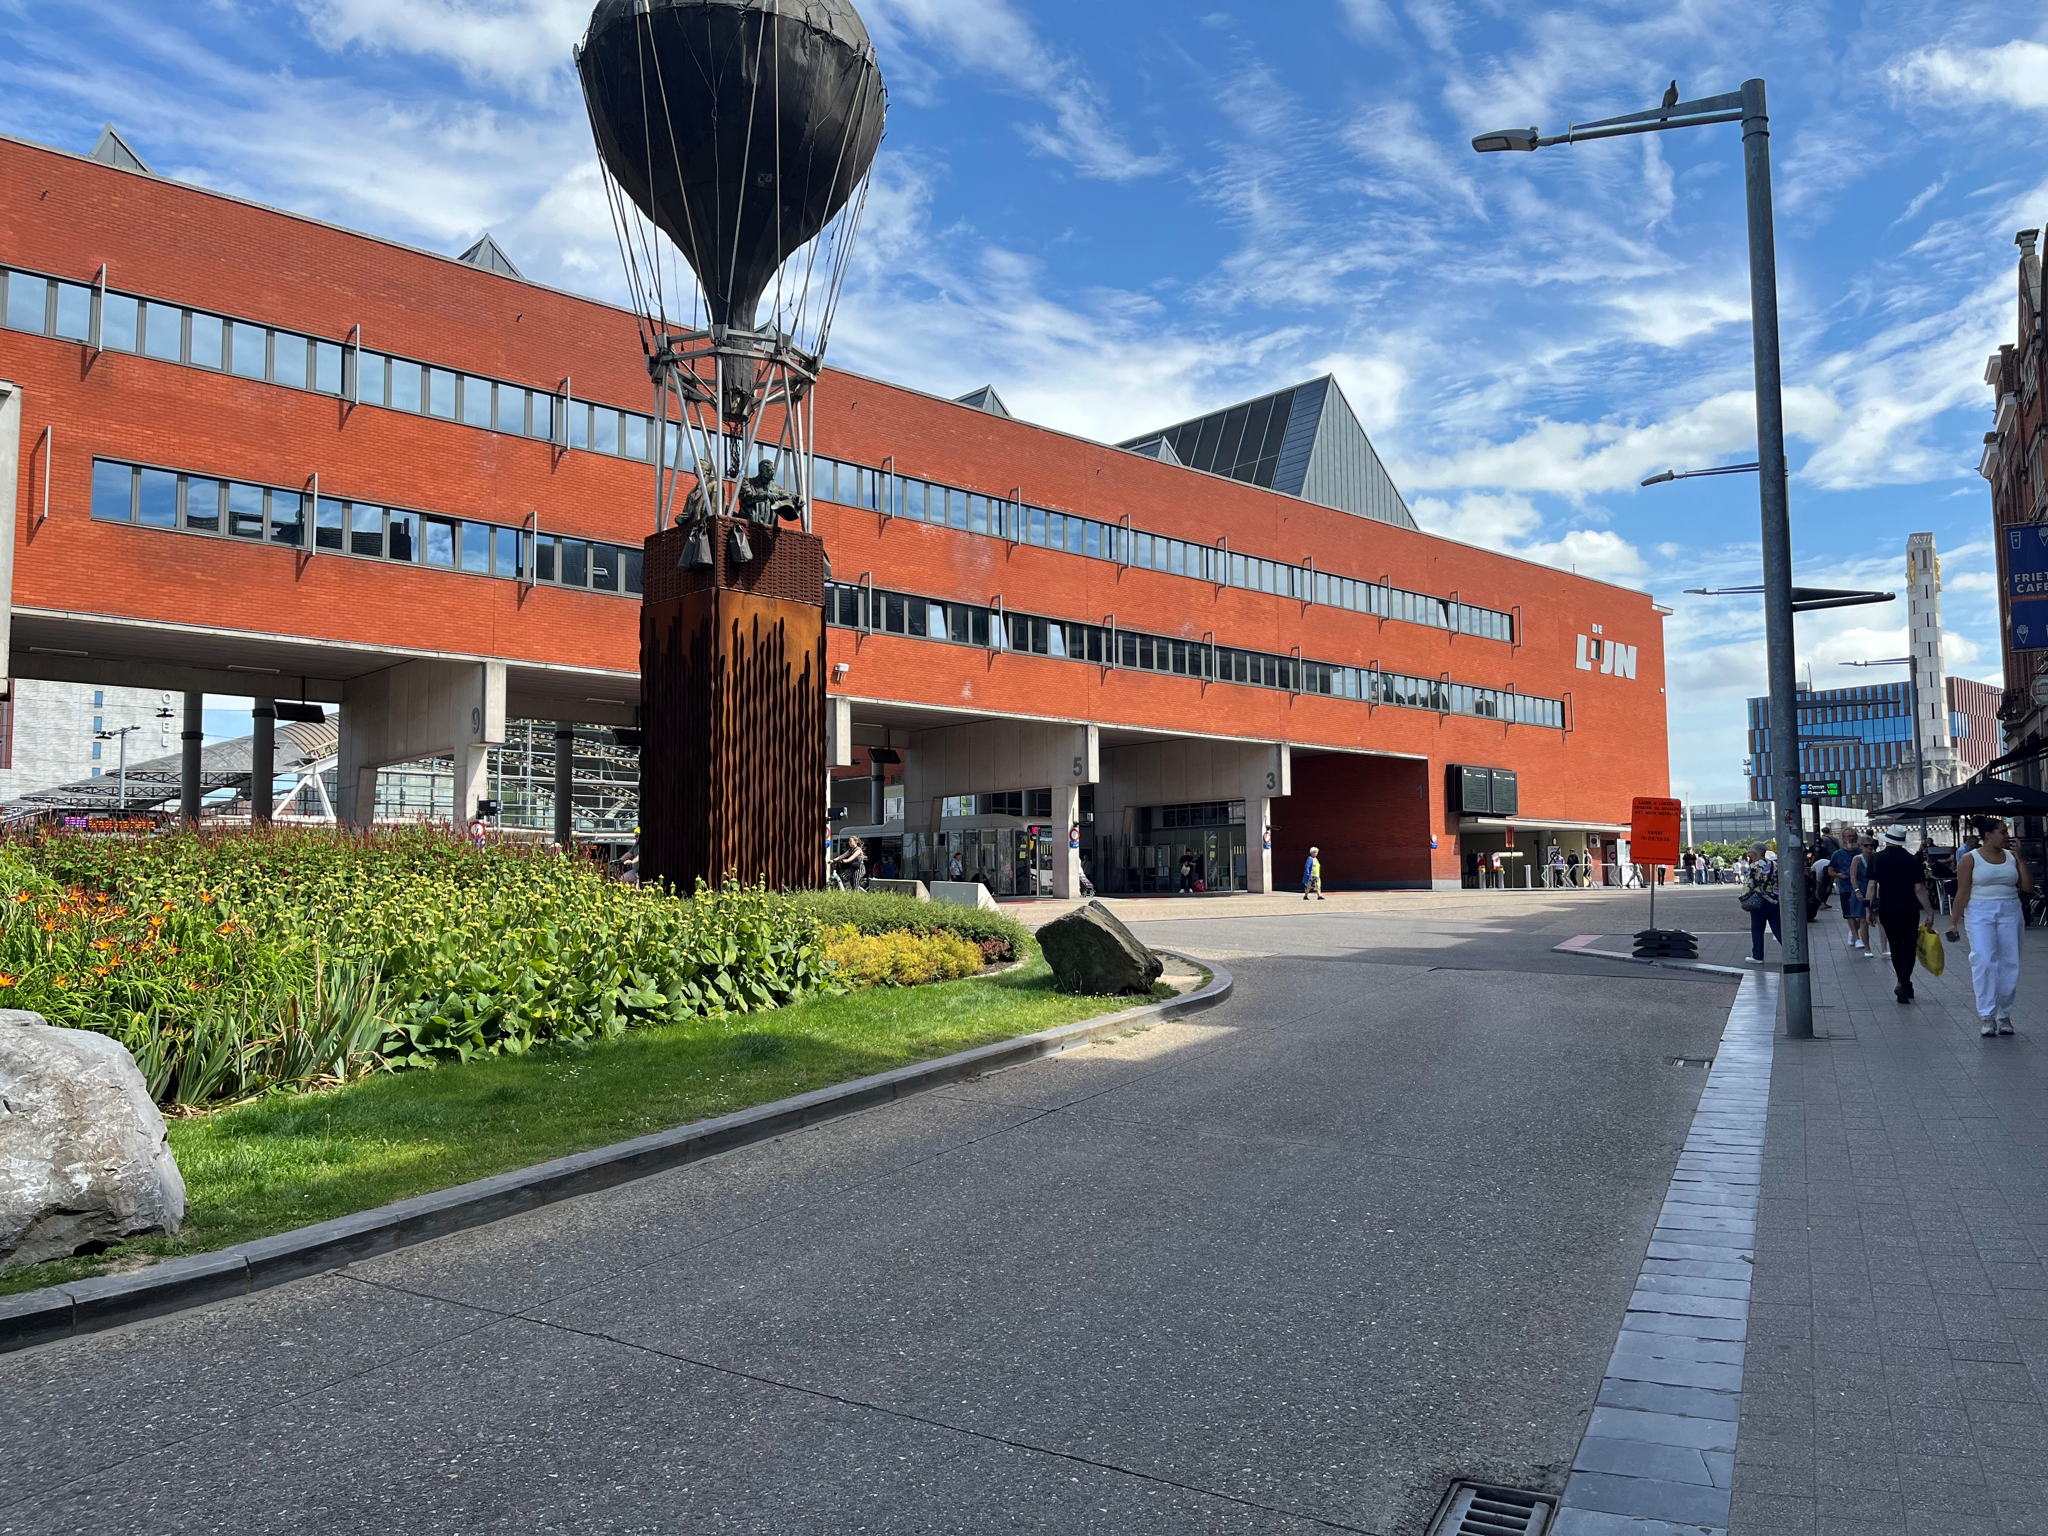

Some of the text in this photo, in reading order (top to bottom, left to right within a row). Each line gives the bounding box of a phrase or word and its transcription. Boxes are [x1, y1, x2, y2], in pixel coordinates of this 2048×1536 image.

[1591, 623, 1603, 634] DE
[1576, 633, 1638, 680] LIJN
[472, 707, 480, 735] 9
[1073, 756, 1083, 777] 5
[1266, 772, 1276, 790] 3
